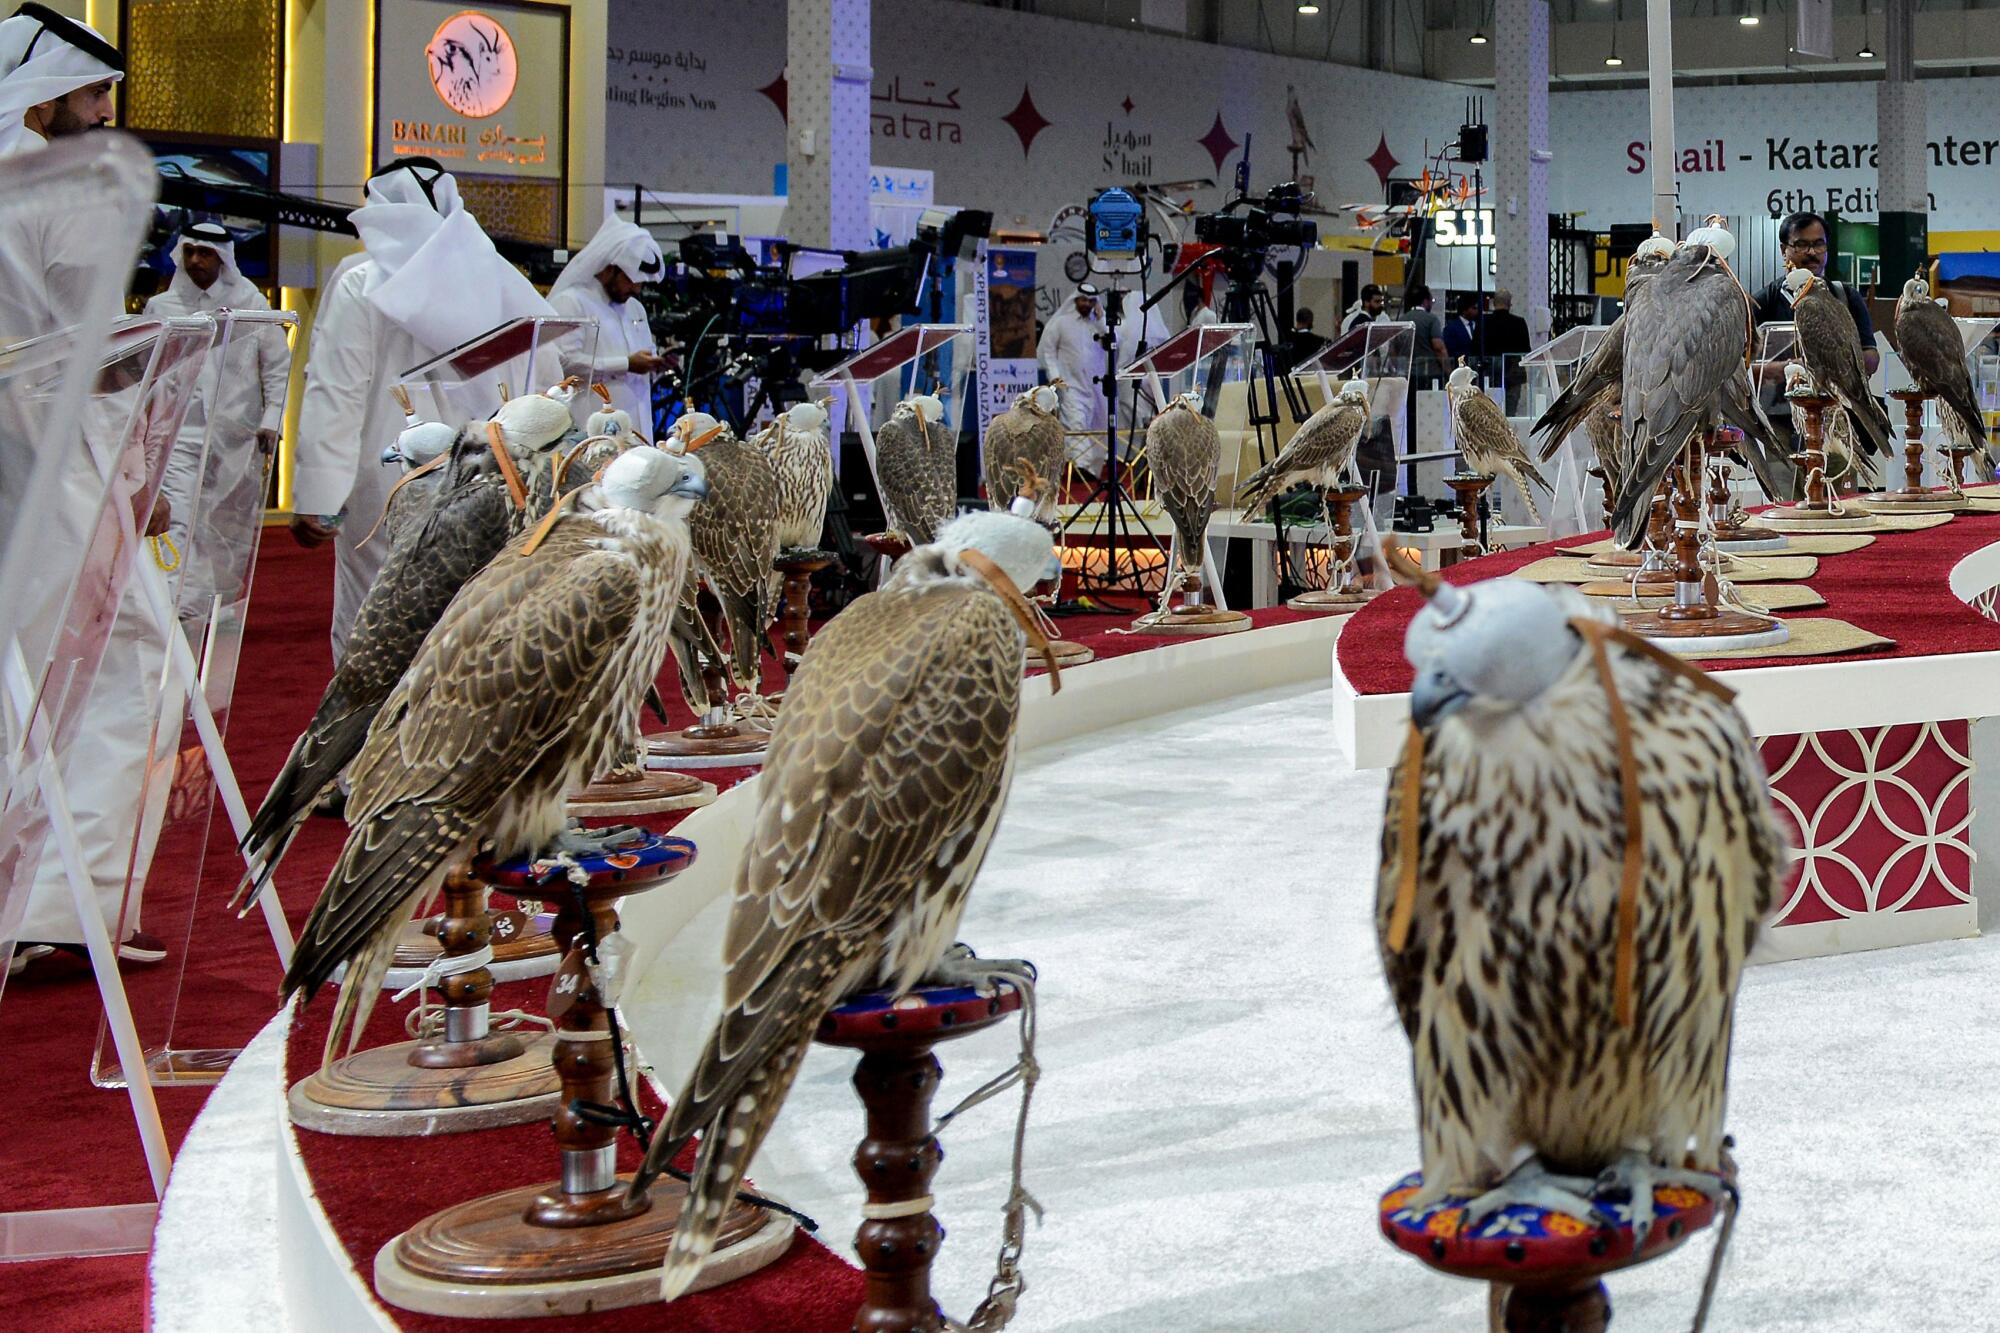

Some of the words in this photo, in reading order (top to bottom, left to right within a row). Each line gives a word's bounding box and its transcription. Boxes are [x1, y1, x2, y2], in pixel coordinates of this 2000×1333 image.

[392, 119, 466, 145] BARARI
[870, 113, 962, 144] atara
[1766, 188, 1816, 214] 6th
[976, 270, 986, 324] XPERTS
[979, 330, 987, 346] IN
[496, 916, 515, 938] 32
[555, 973, 579, 994] 34
